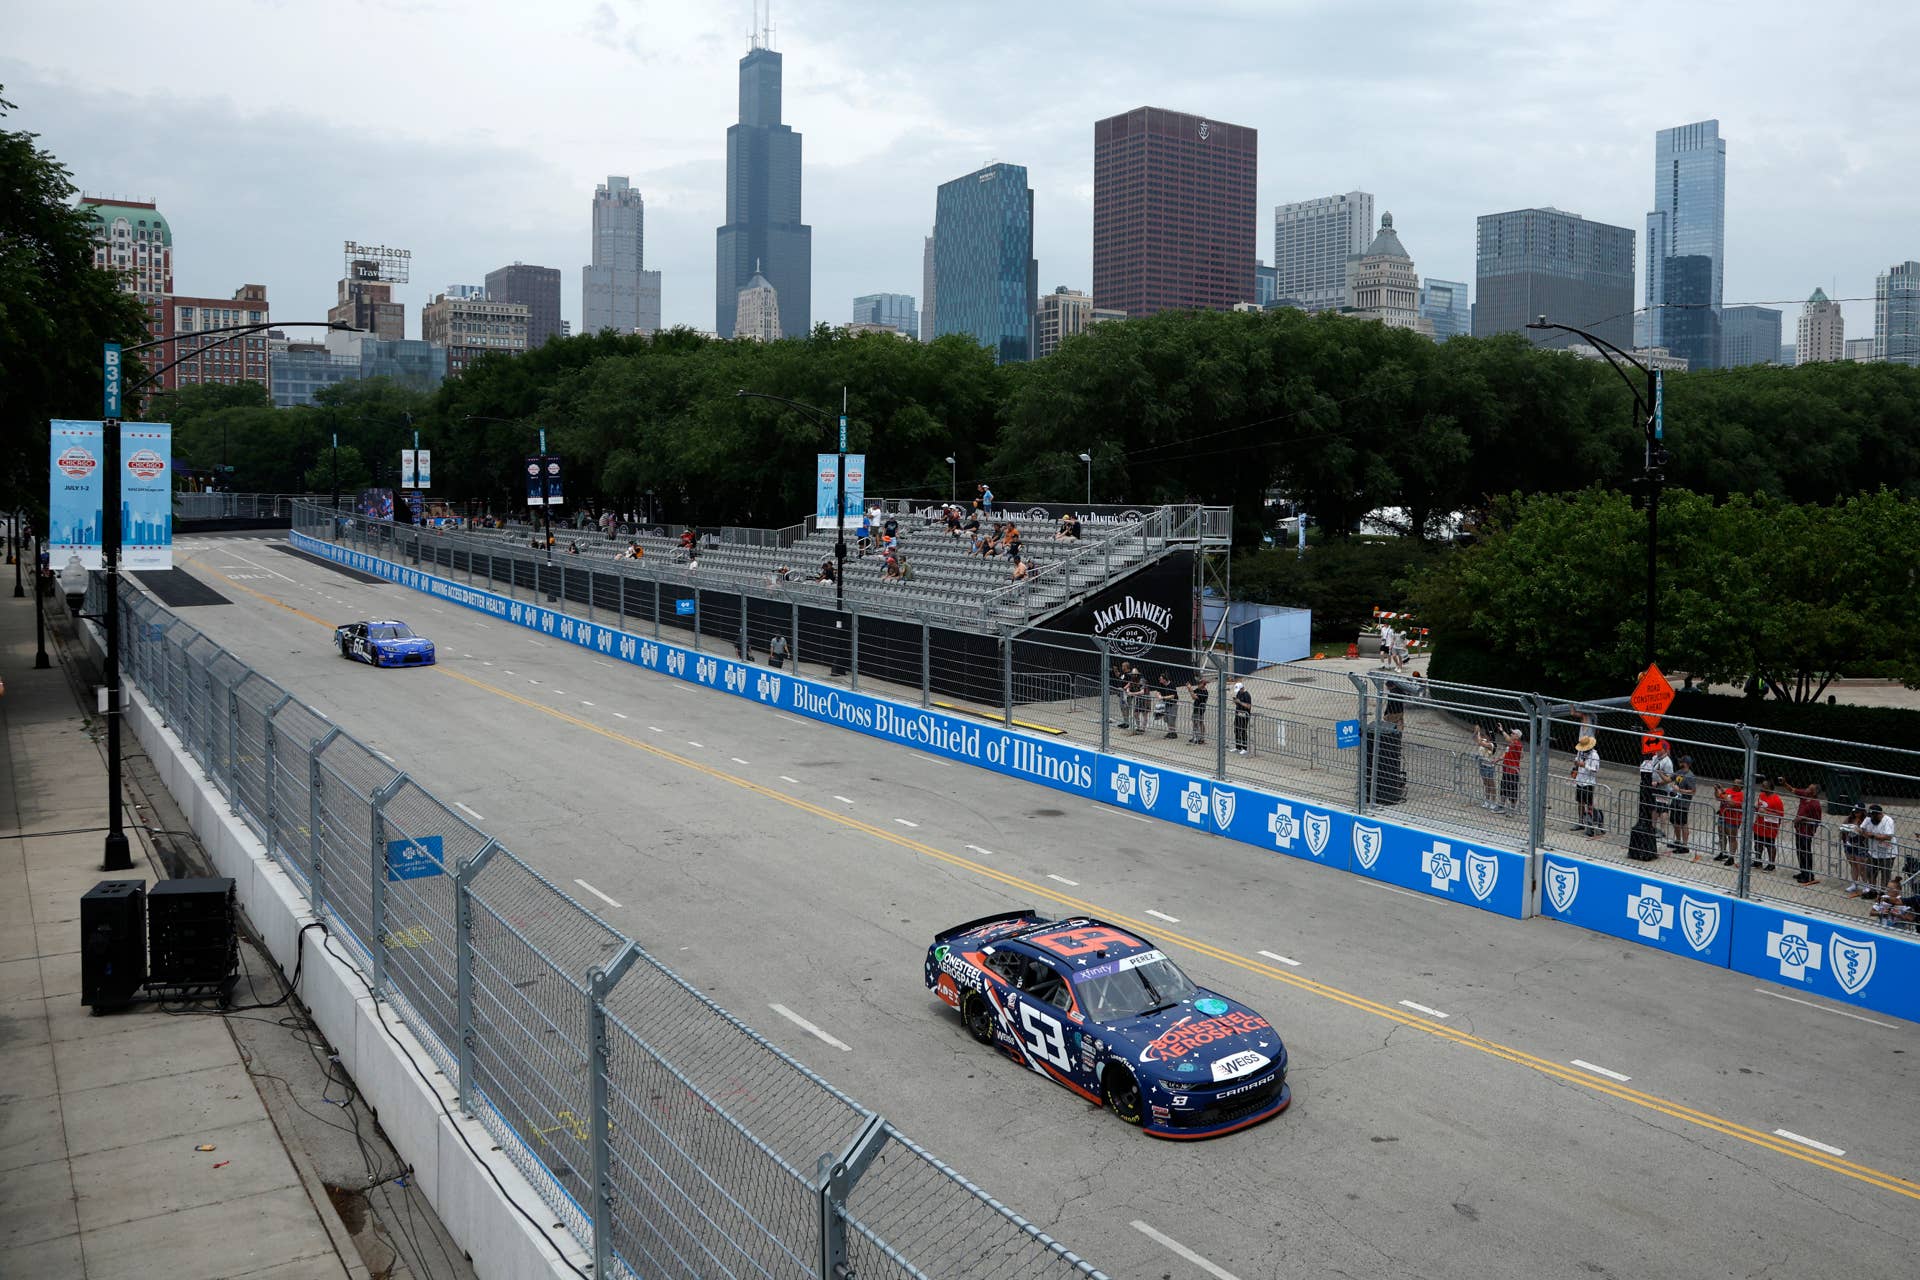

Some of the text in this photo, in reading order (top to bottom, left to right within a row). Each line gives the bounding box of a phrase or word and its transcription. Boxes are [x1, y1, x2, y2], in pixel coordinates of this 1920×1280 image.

[344, 241, 412, 258] Harrison
[105, 350, 119, 410] B341
[61, 459, 93, 467] CHICAGO
[485, 597, 506, 615] HEALTH
[1093, 596, 1173, 634] JACK DANIEL'S
[353, 638, 365, 655] 66
[1634, 692, 1670, 704] CONSTRUCTION
[1646, 703, 1662, 711] AHEAD
[792, 683, 1092, 789] BlueCross BlueShield of Illinois
[1080, 953, 1156, 979] xfinity PEREZ
[1020, 1001, 1071, 1073] 53
[1150, 1011, 1254, 1049] BONESTEEL
[1159, 1017, 1270, 1062] AEROSPACE
[1219, 1052, 1260, 1074] WEISS
[1216, 1074, 1275, 1100] CAMARO
[1171, 1096, 1188, 1106] 53
